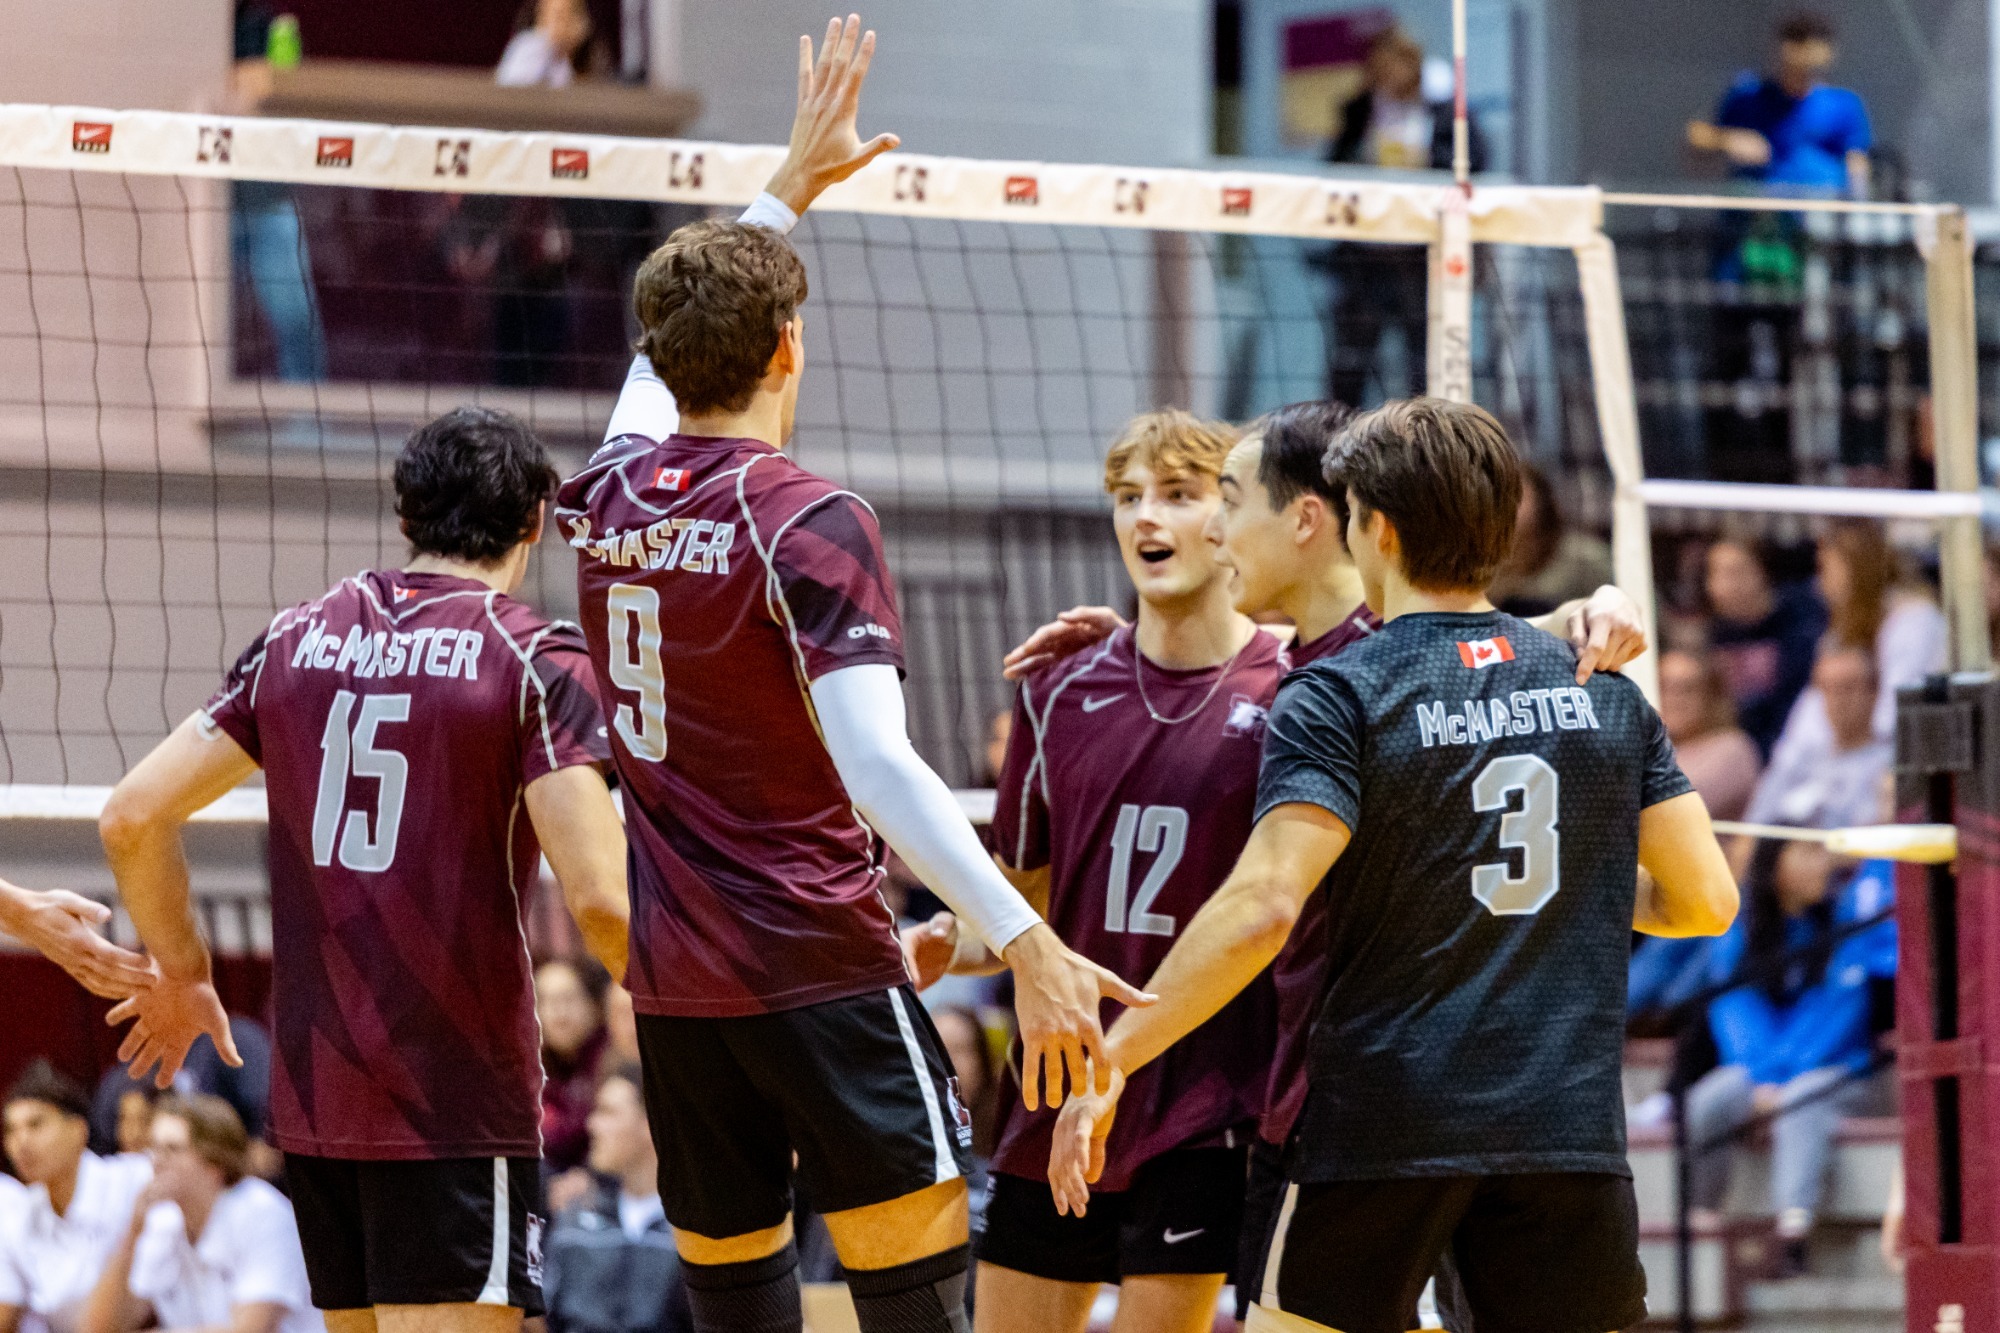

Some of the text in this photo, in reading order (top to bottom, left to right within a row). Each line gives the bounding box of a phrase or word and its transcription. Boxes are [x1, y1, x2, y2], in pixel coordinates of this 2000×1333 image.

[291, 618, 484, 680] McMASTER
[607, 582, 667, 762] 9
[847, 622, 891, 640] OUA
[311, 689, 412, 873] 15
[1416, 687, 1600, 747] McMASTER
[1104, 803, 1189, 937] 12
[1471, 753, 1560, 916] 3
